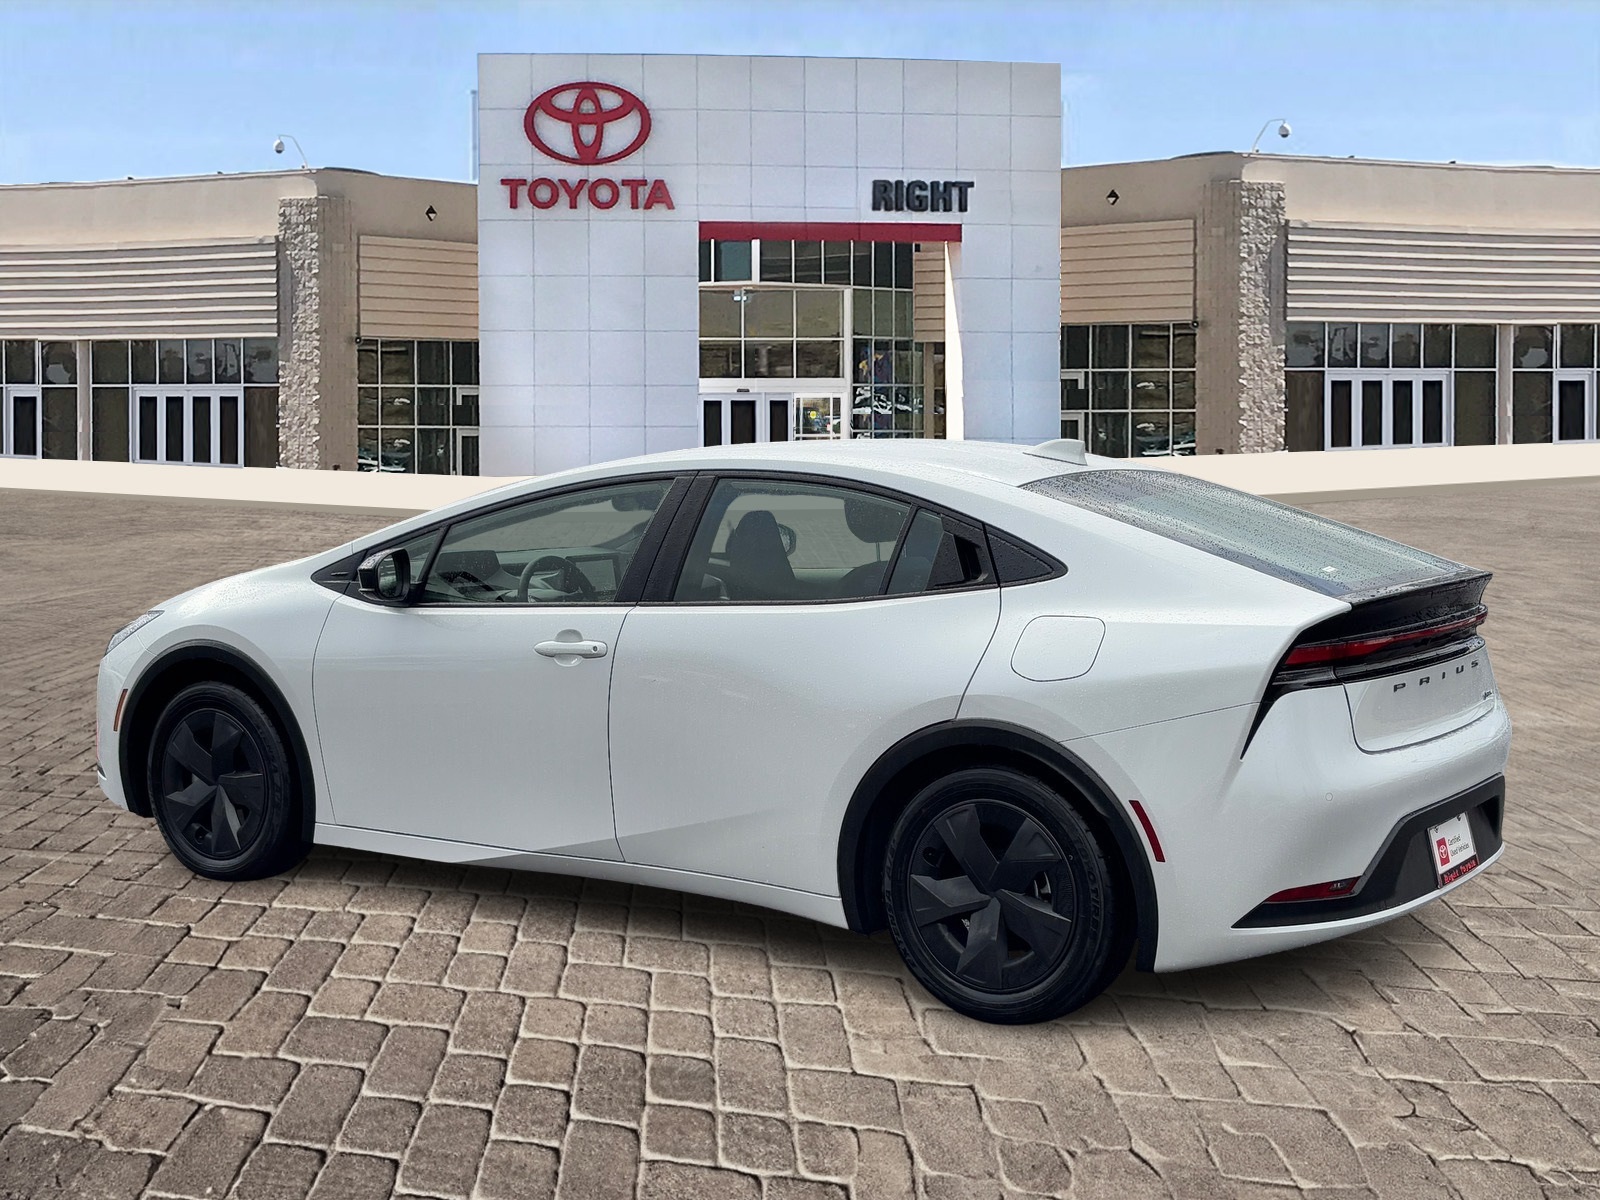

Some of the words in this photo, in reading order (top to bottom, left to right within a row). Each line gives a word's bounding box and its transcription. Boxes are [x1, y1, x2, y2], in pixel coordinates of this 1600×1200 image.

[500, 178, 675, 210] TOYOTA
[872, 179, 975, 213] RIGHT
[1393, 660, 1479, 693] PRIUS
[1448, 834, 1461, 846] Certified
[1443, 869, 1459, 884] Right
